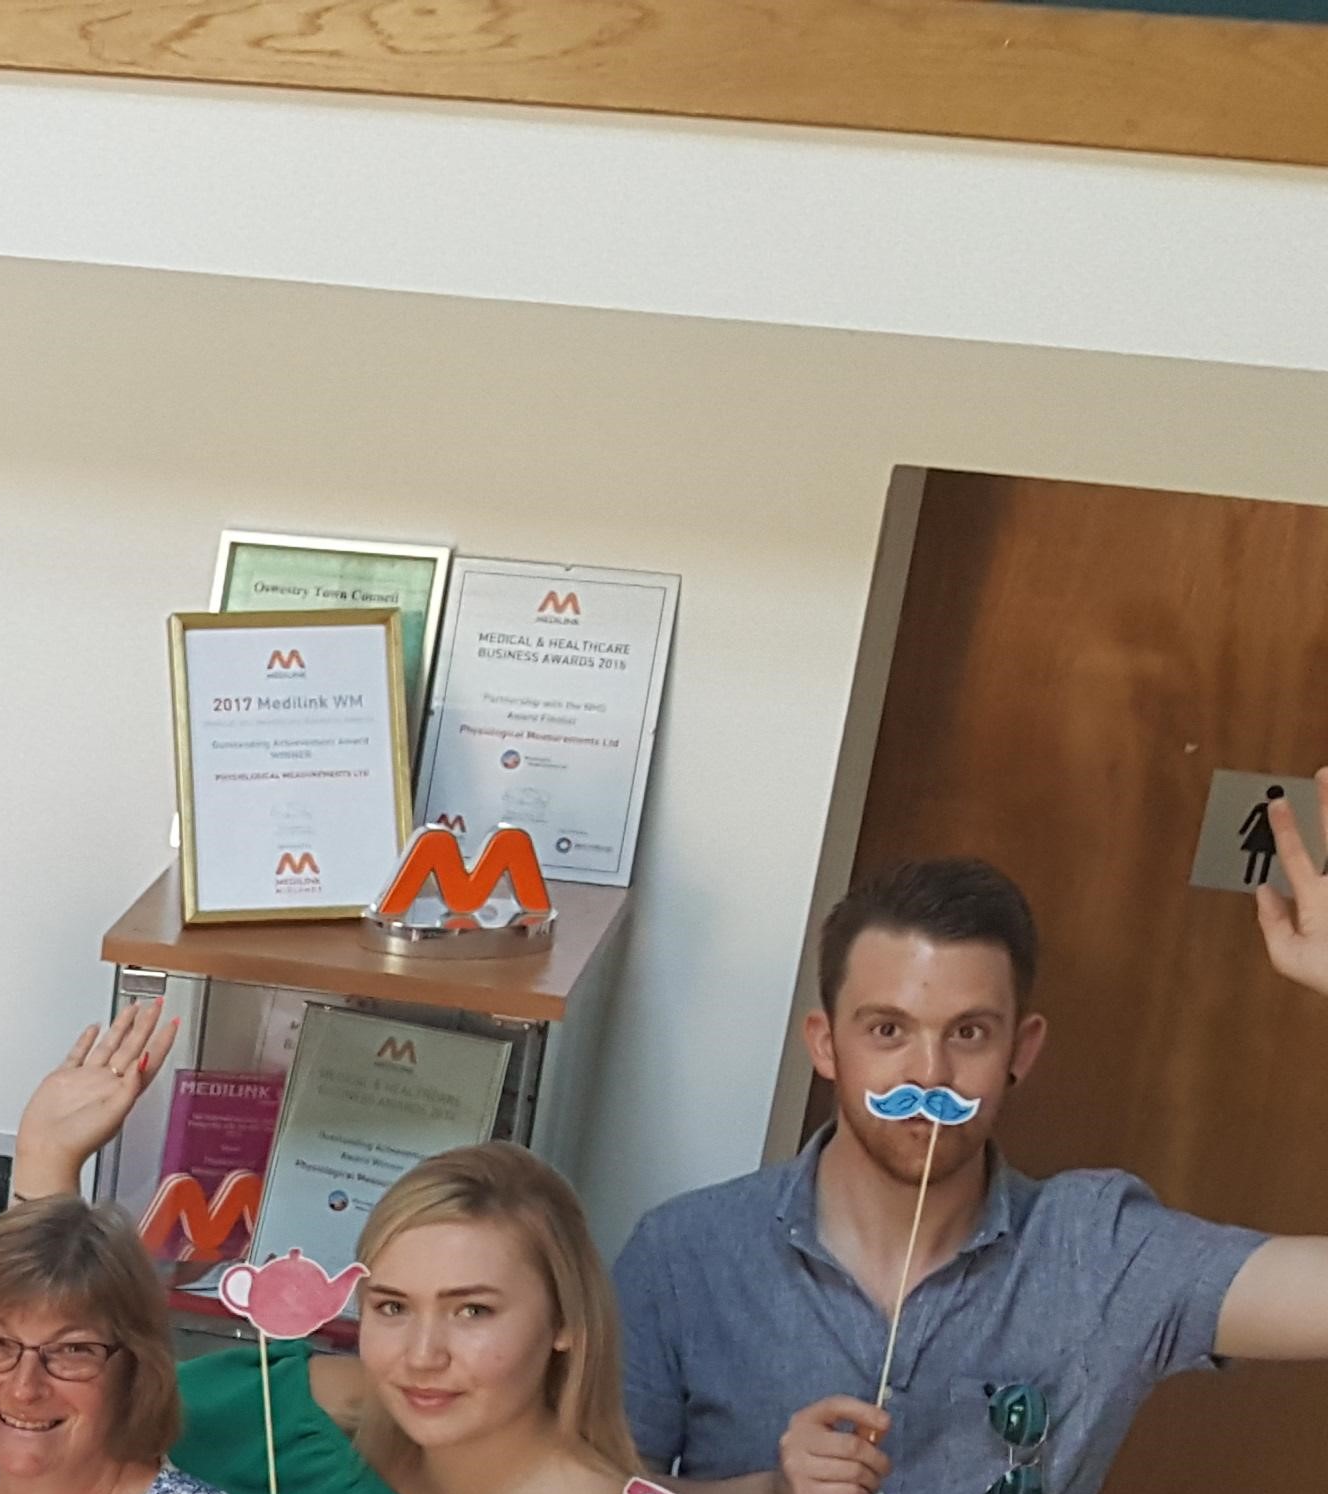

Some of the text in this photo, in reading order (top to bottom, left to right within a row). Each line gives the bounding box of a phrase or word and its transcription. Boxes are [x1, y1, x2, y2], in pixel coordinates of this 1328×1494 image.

[478, 632, 631, 656] MEDICAL & HEALTHCARE
[478, 647, 595, 669] BUSINESS AWARDS
[212, 693, 363, 712] 2017 Medilink WM
[180, 1080, 271, 1099] MEDILINK
